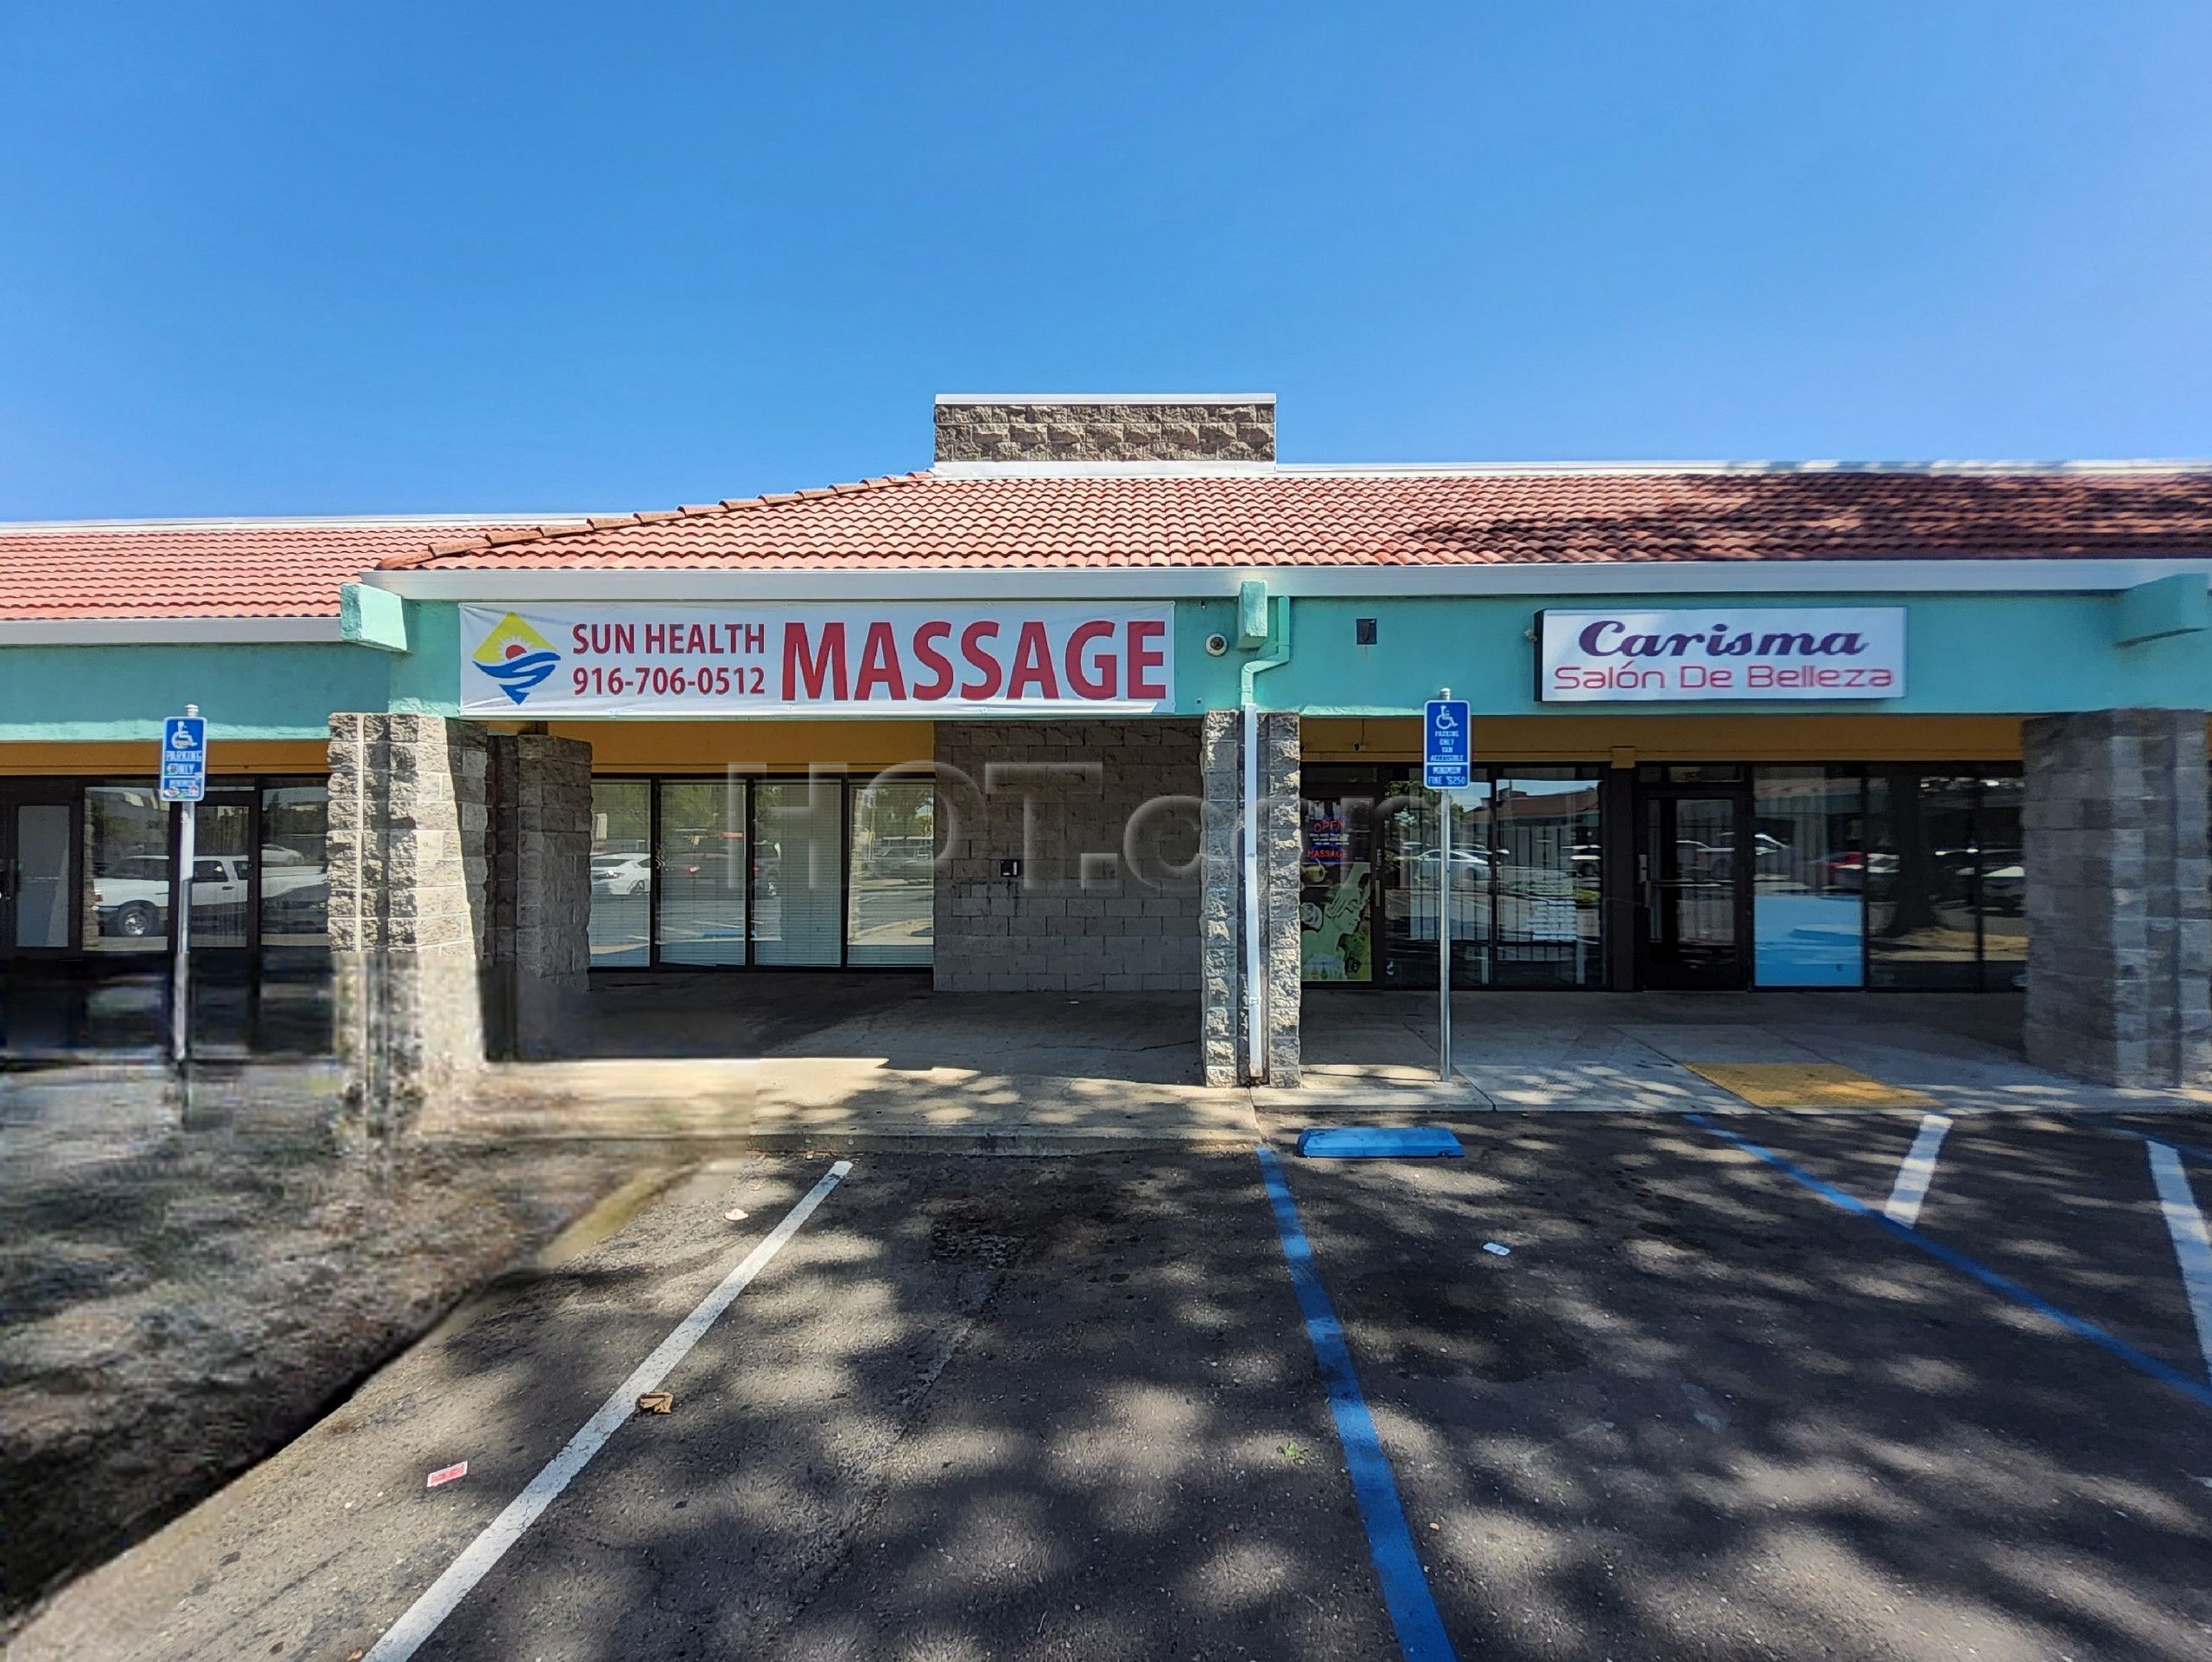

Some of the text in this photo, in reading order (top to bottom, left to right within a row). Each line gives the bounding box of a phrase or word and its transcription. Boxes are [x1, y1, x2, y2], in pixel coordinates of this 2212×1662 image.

[572, 623, 765, 654] SUN HEALTH
[1578, 621, 1870, 657] Carisma
[781, 621, 1166, 701] MASSAGE
[1554, 660, 1894, 689] Salón De Belleza
[573, 667, 766, 695] 916-706-0512
